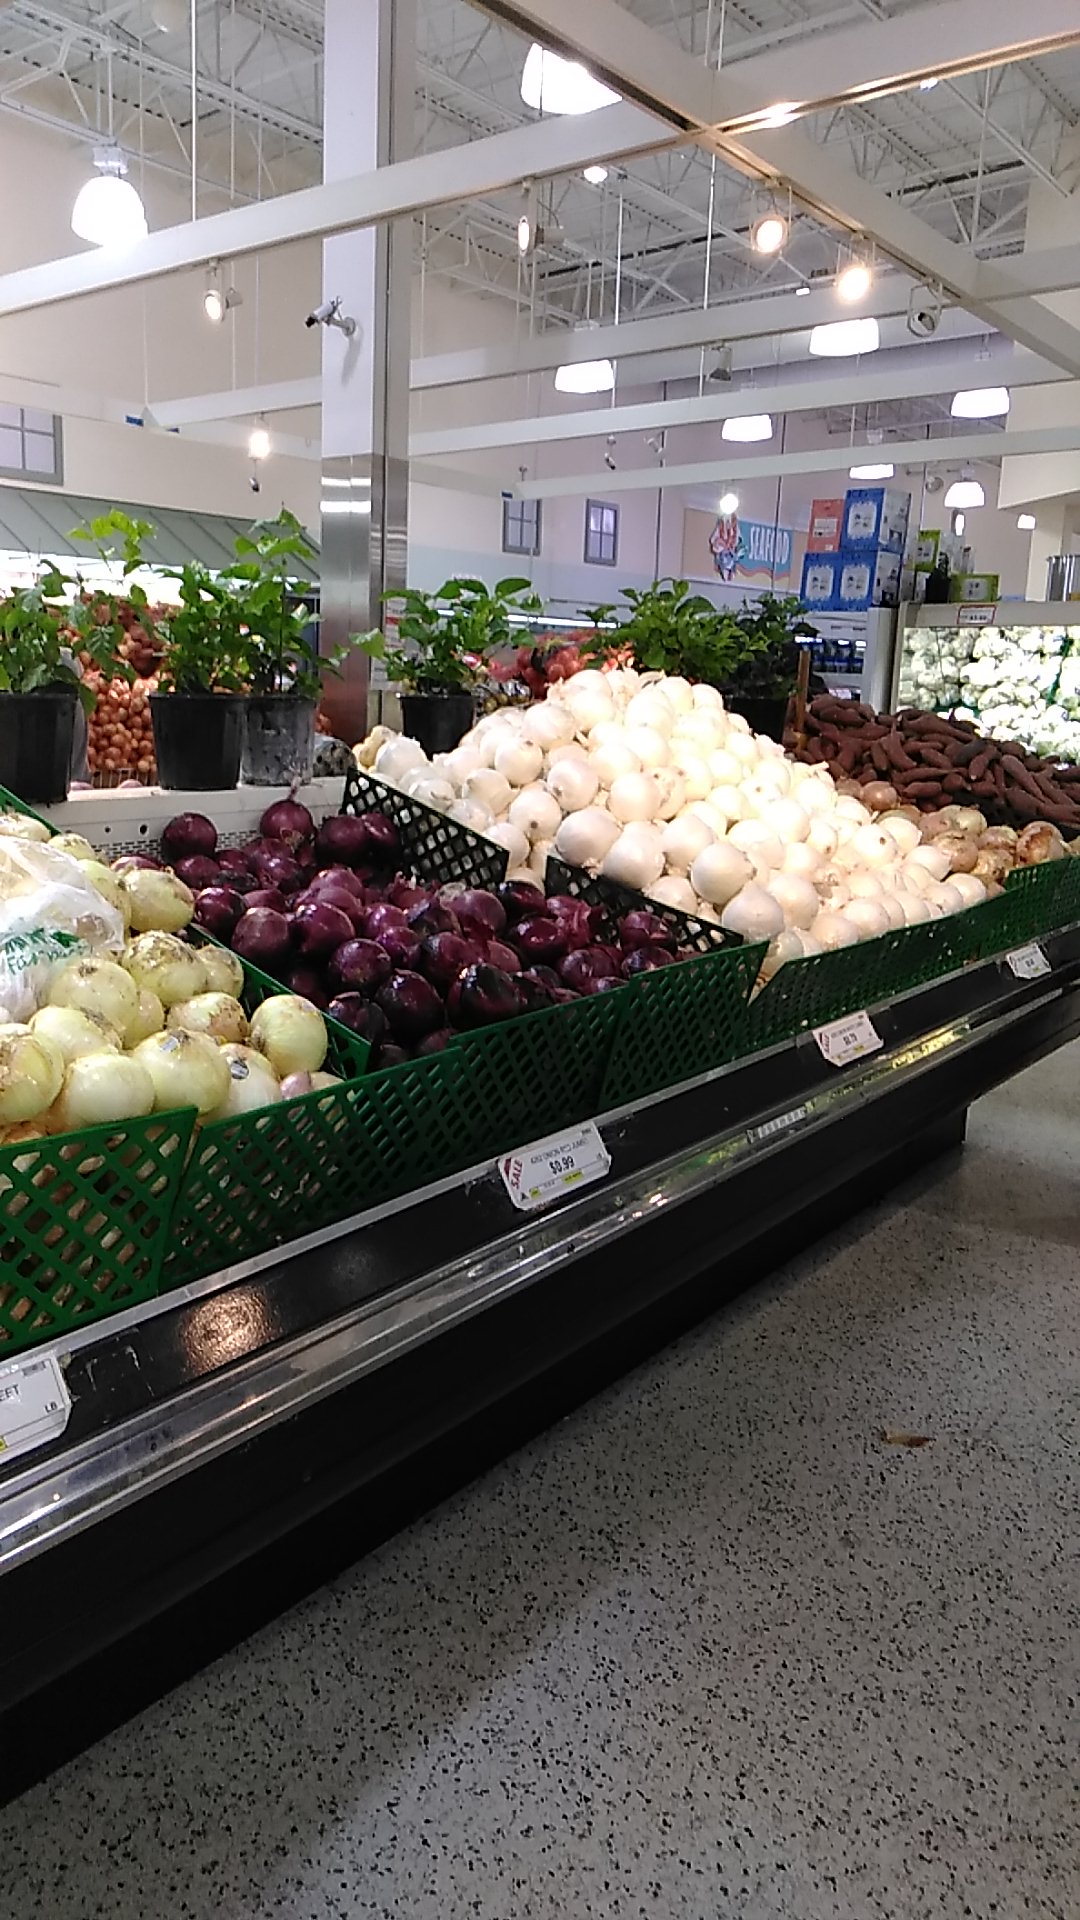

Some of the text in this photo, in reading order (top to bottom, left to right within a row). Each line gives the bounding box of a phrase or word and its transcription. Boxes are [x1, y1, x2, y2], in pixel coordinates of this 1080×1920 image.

[749, 525, 790, 566] SEAFOOD
[510, 1159, 523, 1190] SALE
[549, 1155, 575, 1175] $0.99
[44, 1401, 58, 1413] LB
